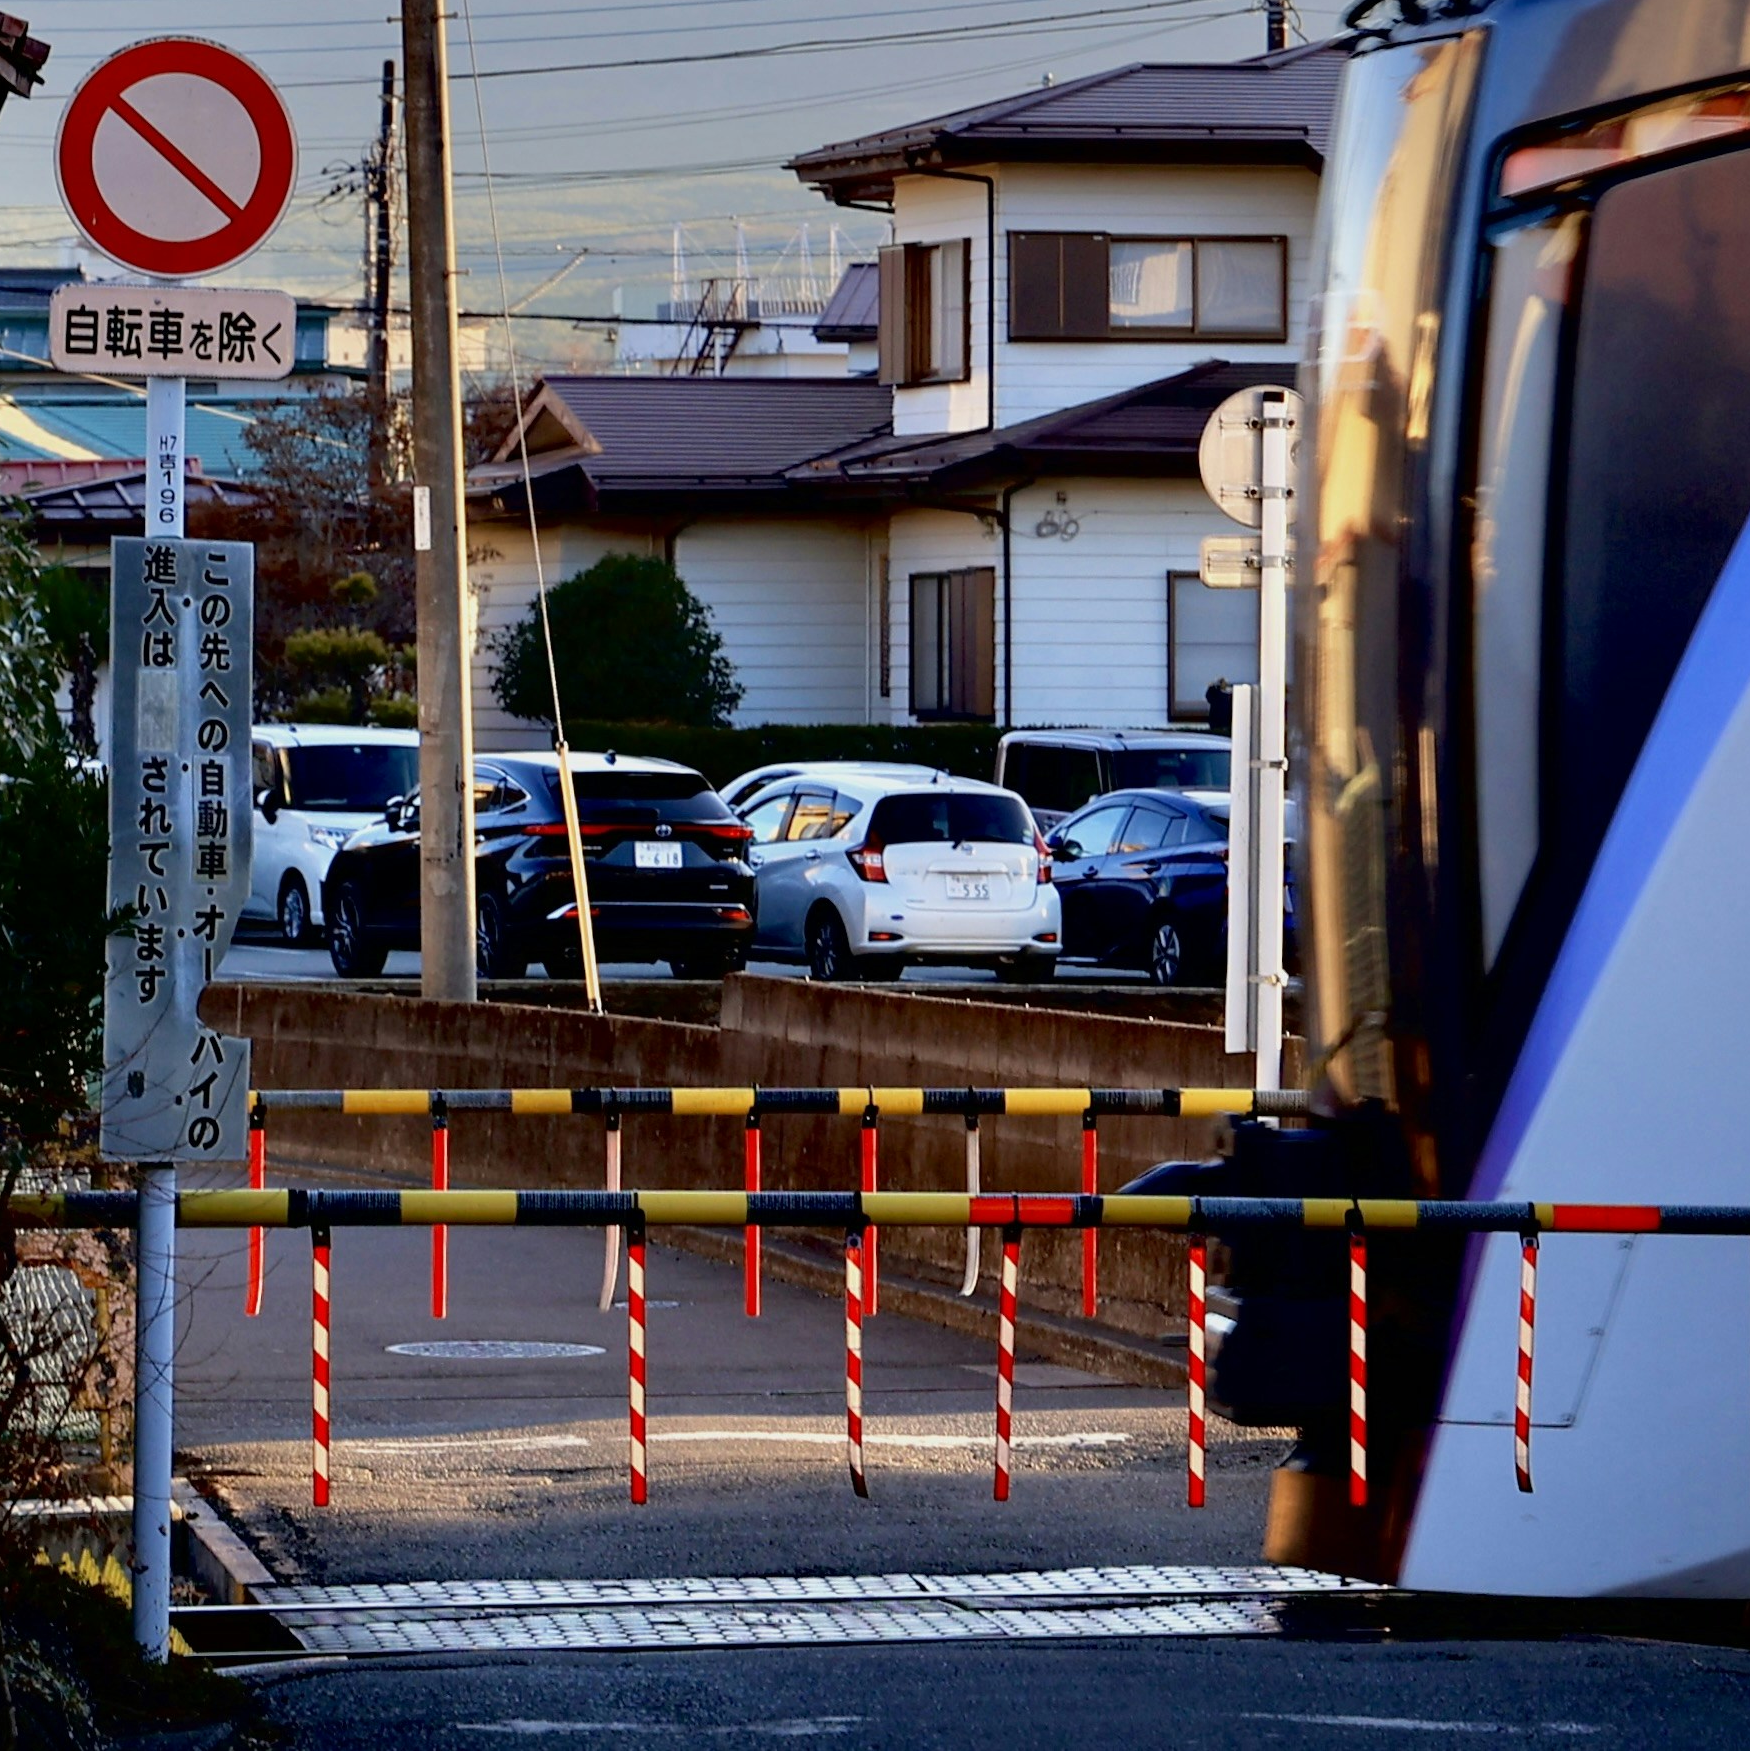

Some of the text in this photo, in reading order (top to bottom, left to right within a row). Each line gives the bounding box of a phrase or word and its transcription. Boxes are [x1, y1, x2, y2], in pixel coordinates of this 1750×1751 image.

[65, 304, 282, 364] 自転車を除く
[187, 553, 231, 1151] この先への自動車・オーバイの
